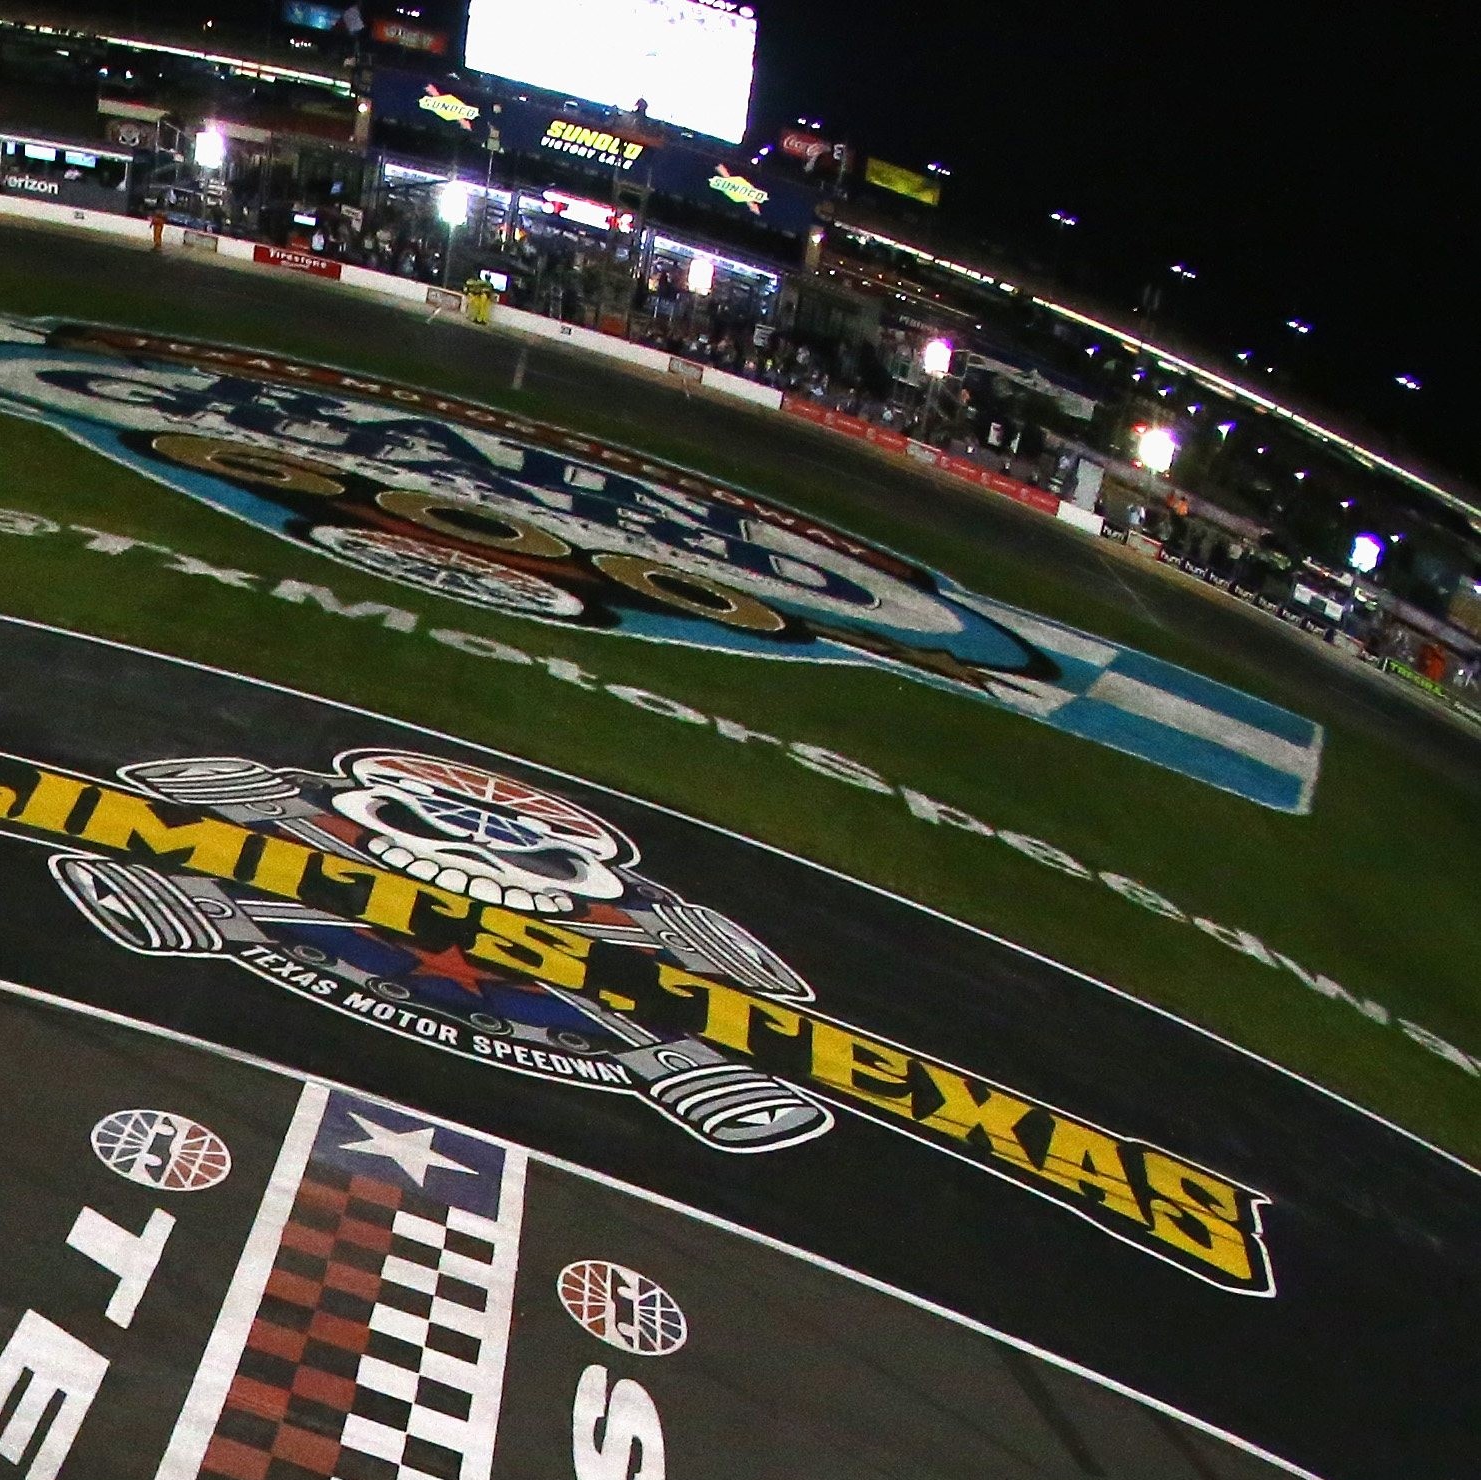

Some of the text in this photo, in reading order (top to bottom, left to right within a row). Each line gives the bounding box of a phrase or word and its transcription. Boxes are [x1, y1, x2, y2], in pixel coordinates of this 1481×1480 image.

[241, 943, 634, 1087] TEXAS MOTOR SPEEDWAY
[658, 961, 1253, 1280] TEXAS
